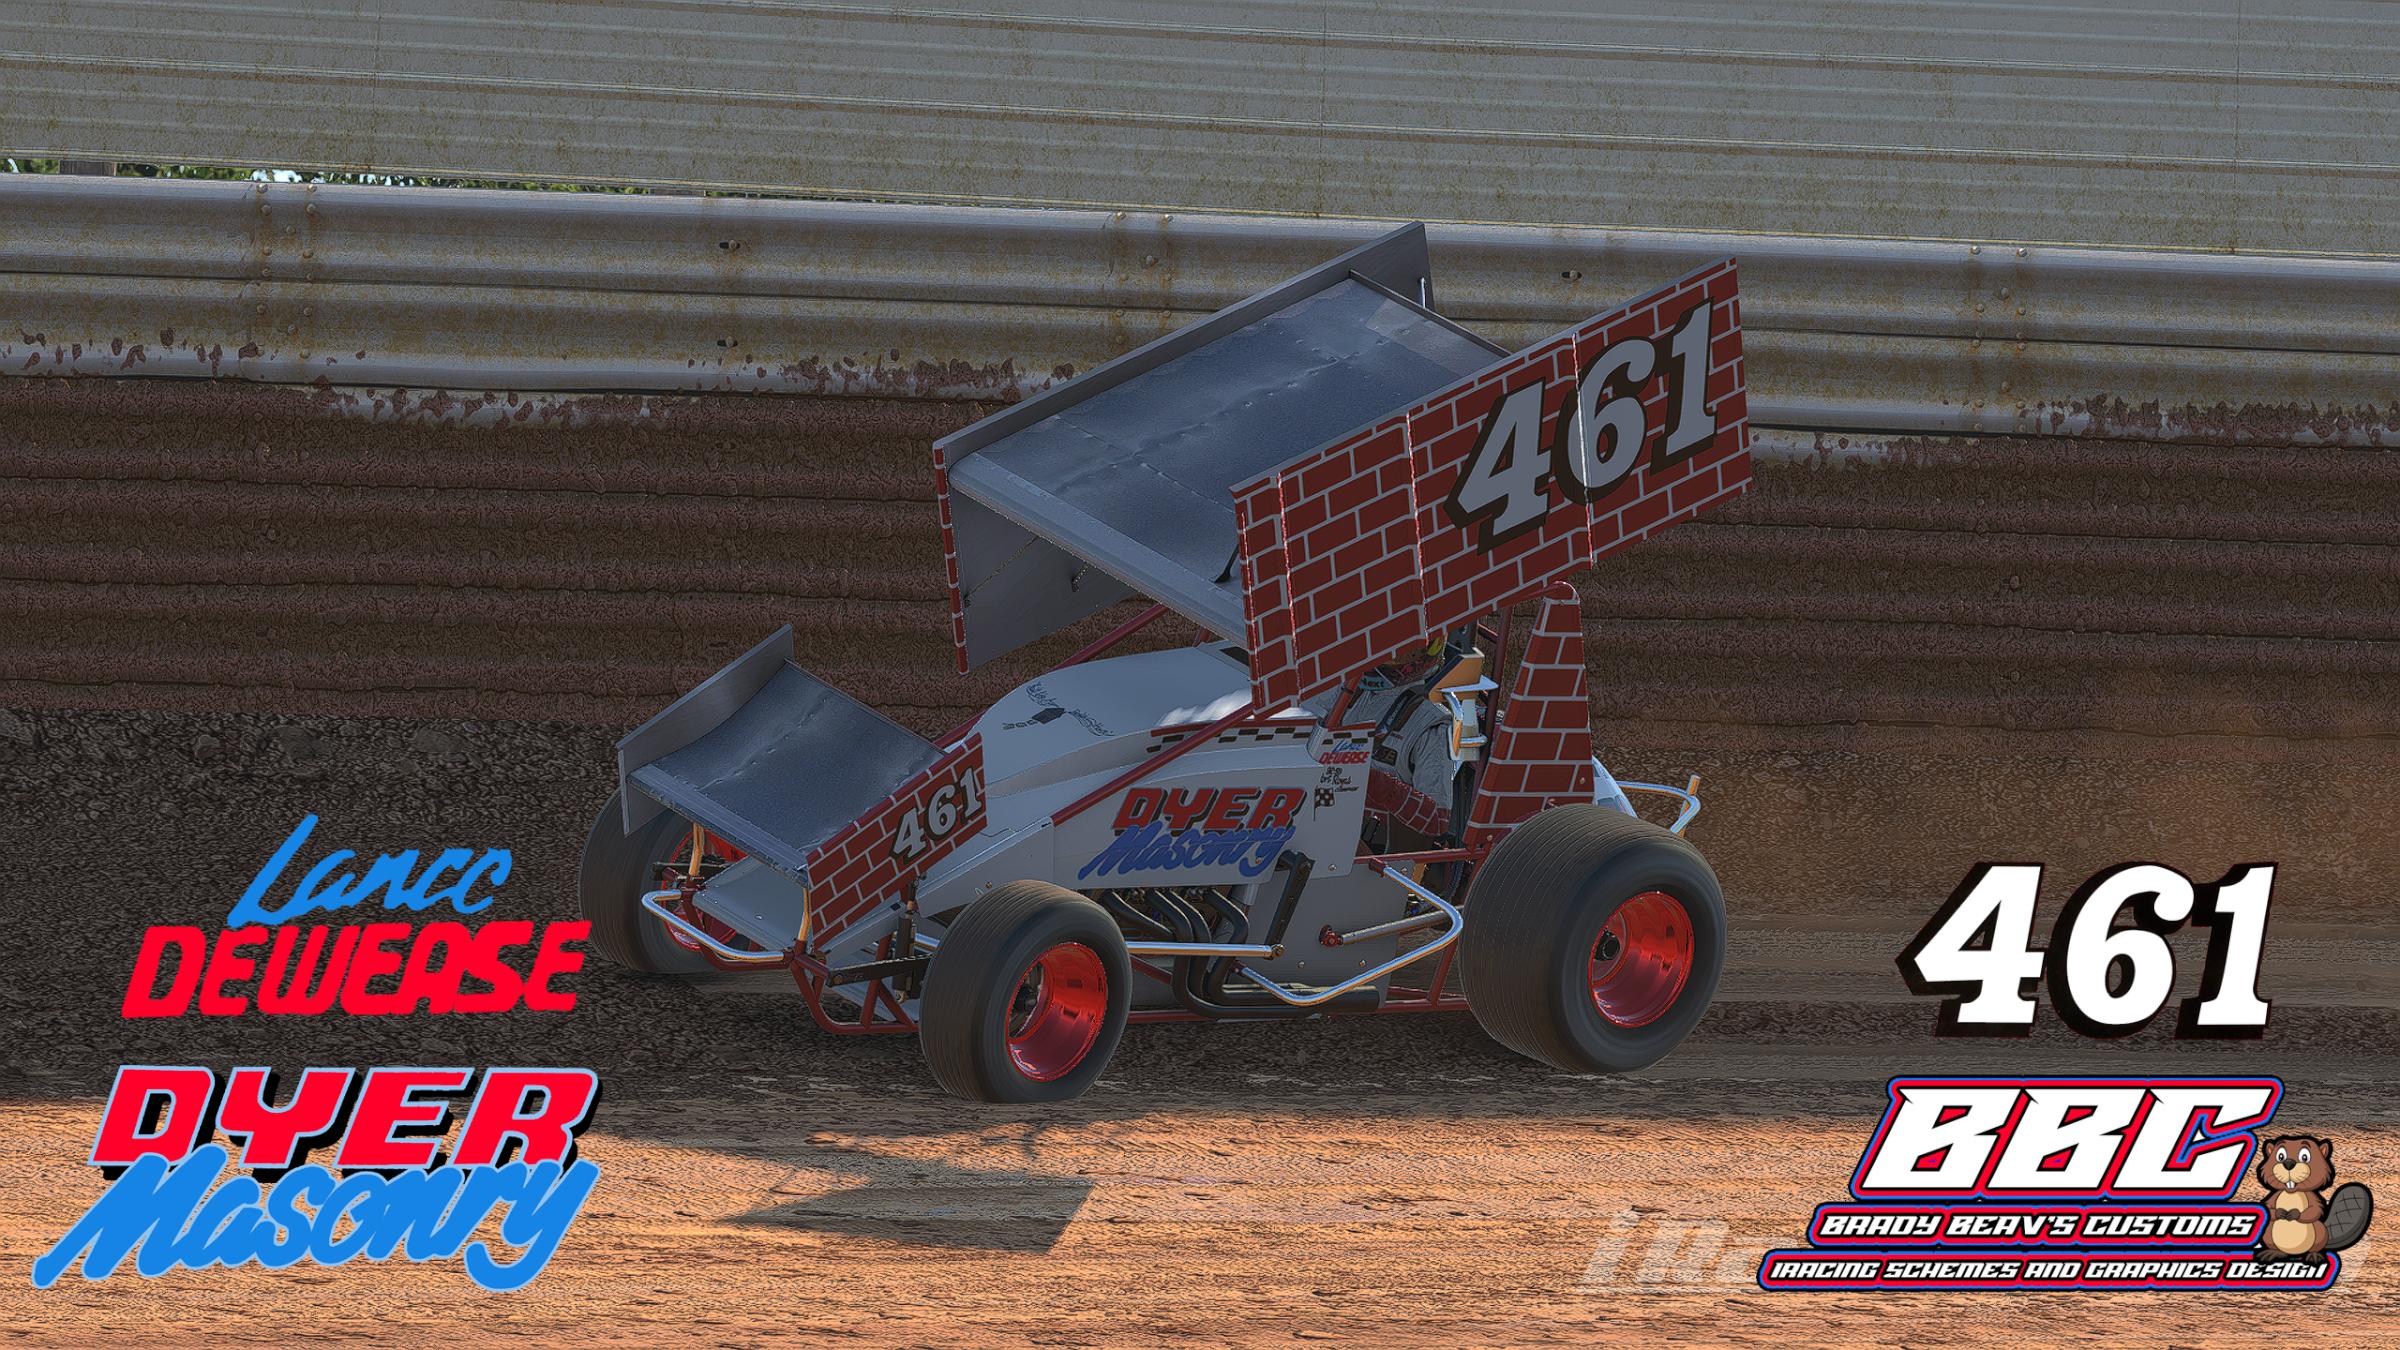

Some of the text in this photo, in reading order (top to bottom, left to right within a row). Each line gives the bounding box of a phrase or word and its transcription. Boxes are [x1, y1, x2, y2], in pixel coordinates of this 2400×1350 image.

[1445, 297, 1716, 553] 461
[890, 766, 982, 862] 461
[1077, 820, 1296, 880] Masonry
[1112, 787, 1308, 837] DYER
